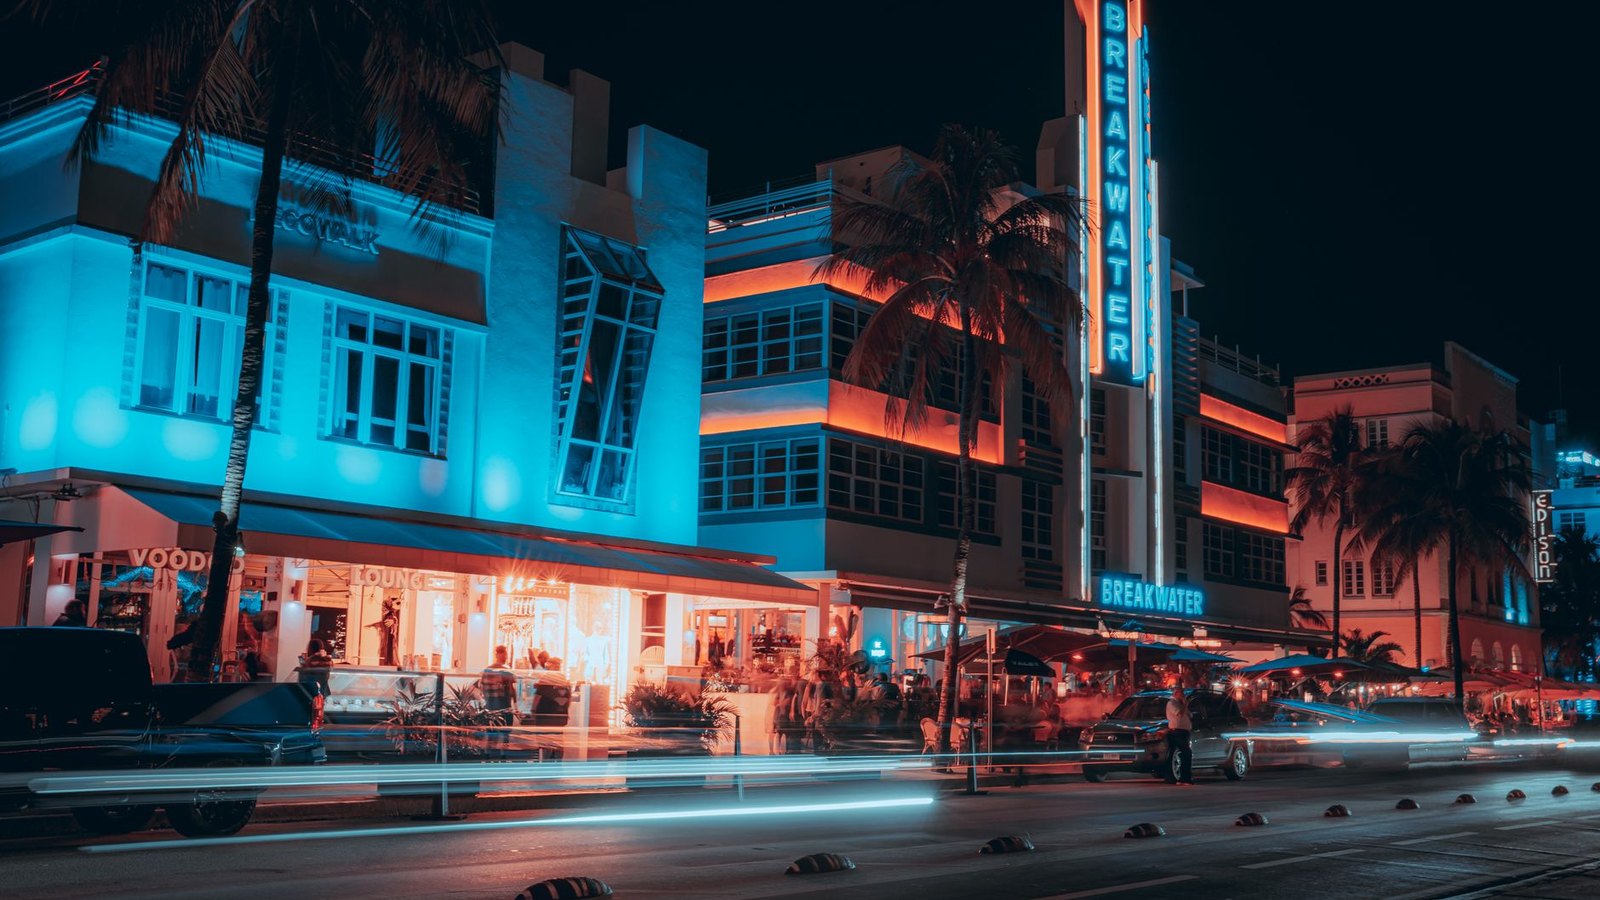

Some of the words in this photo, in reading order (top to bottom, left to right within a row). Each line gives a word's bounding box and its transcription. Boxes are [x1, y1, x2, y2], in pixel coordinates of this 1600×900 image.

[1104, 2, 1129, 363] BREAKWATER
[128, 547, 245, 574] VOODO
[1102, 578, 1203, 615] BREAKWATER
